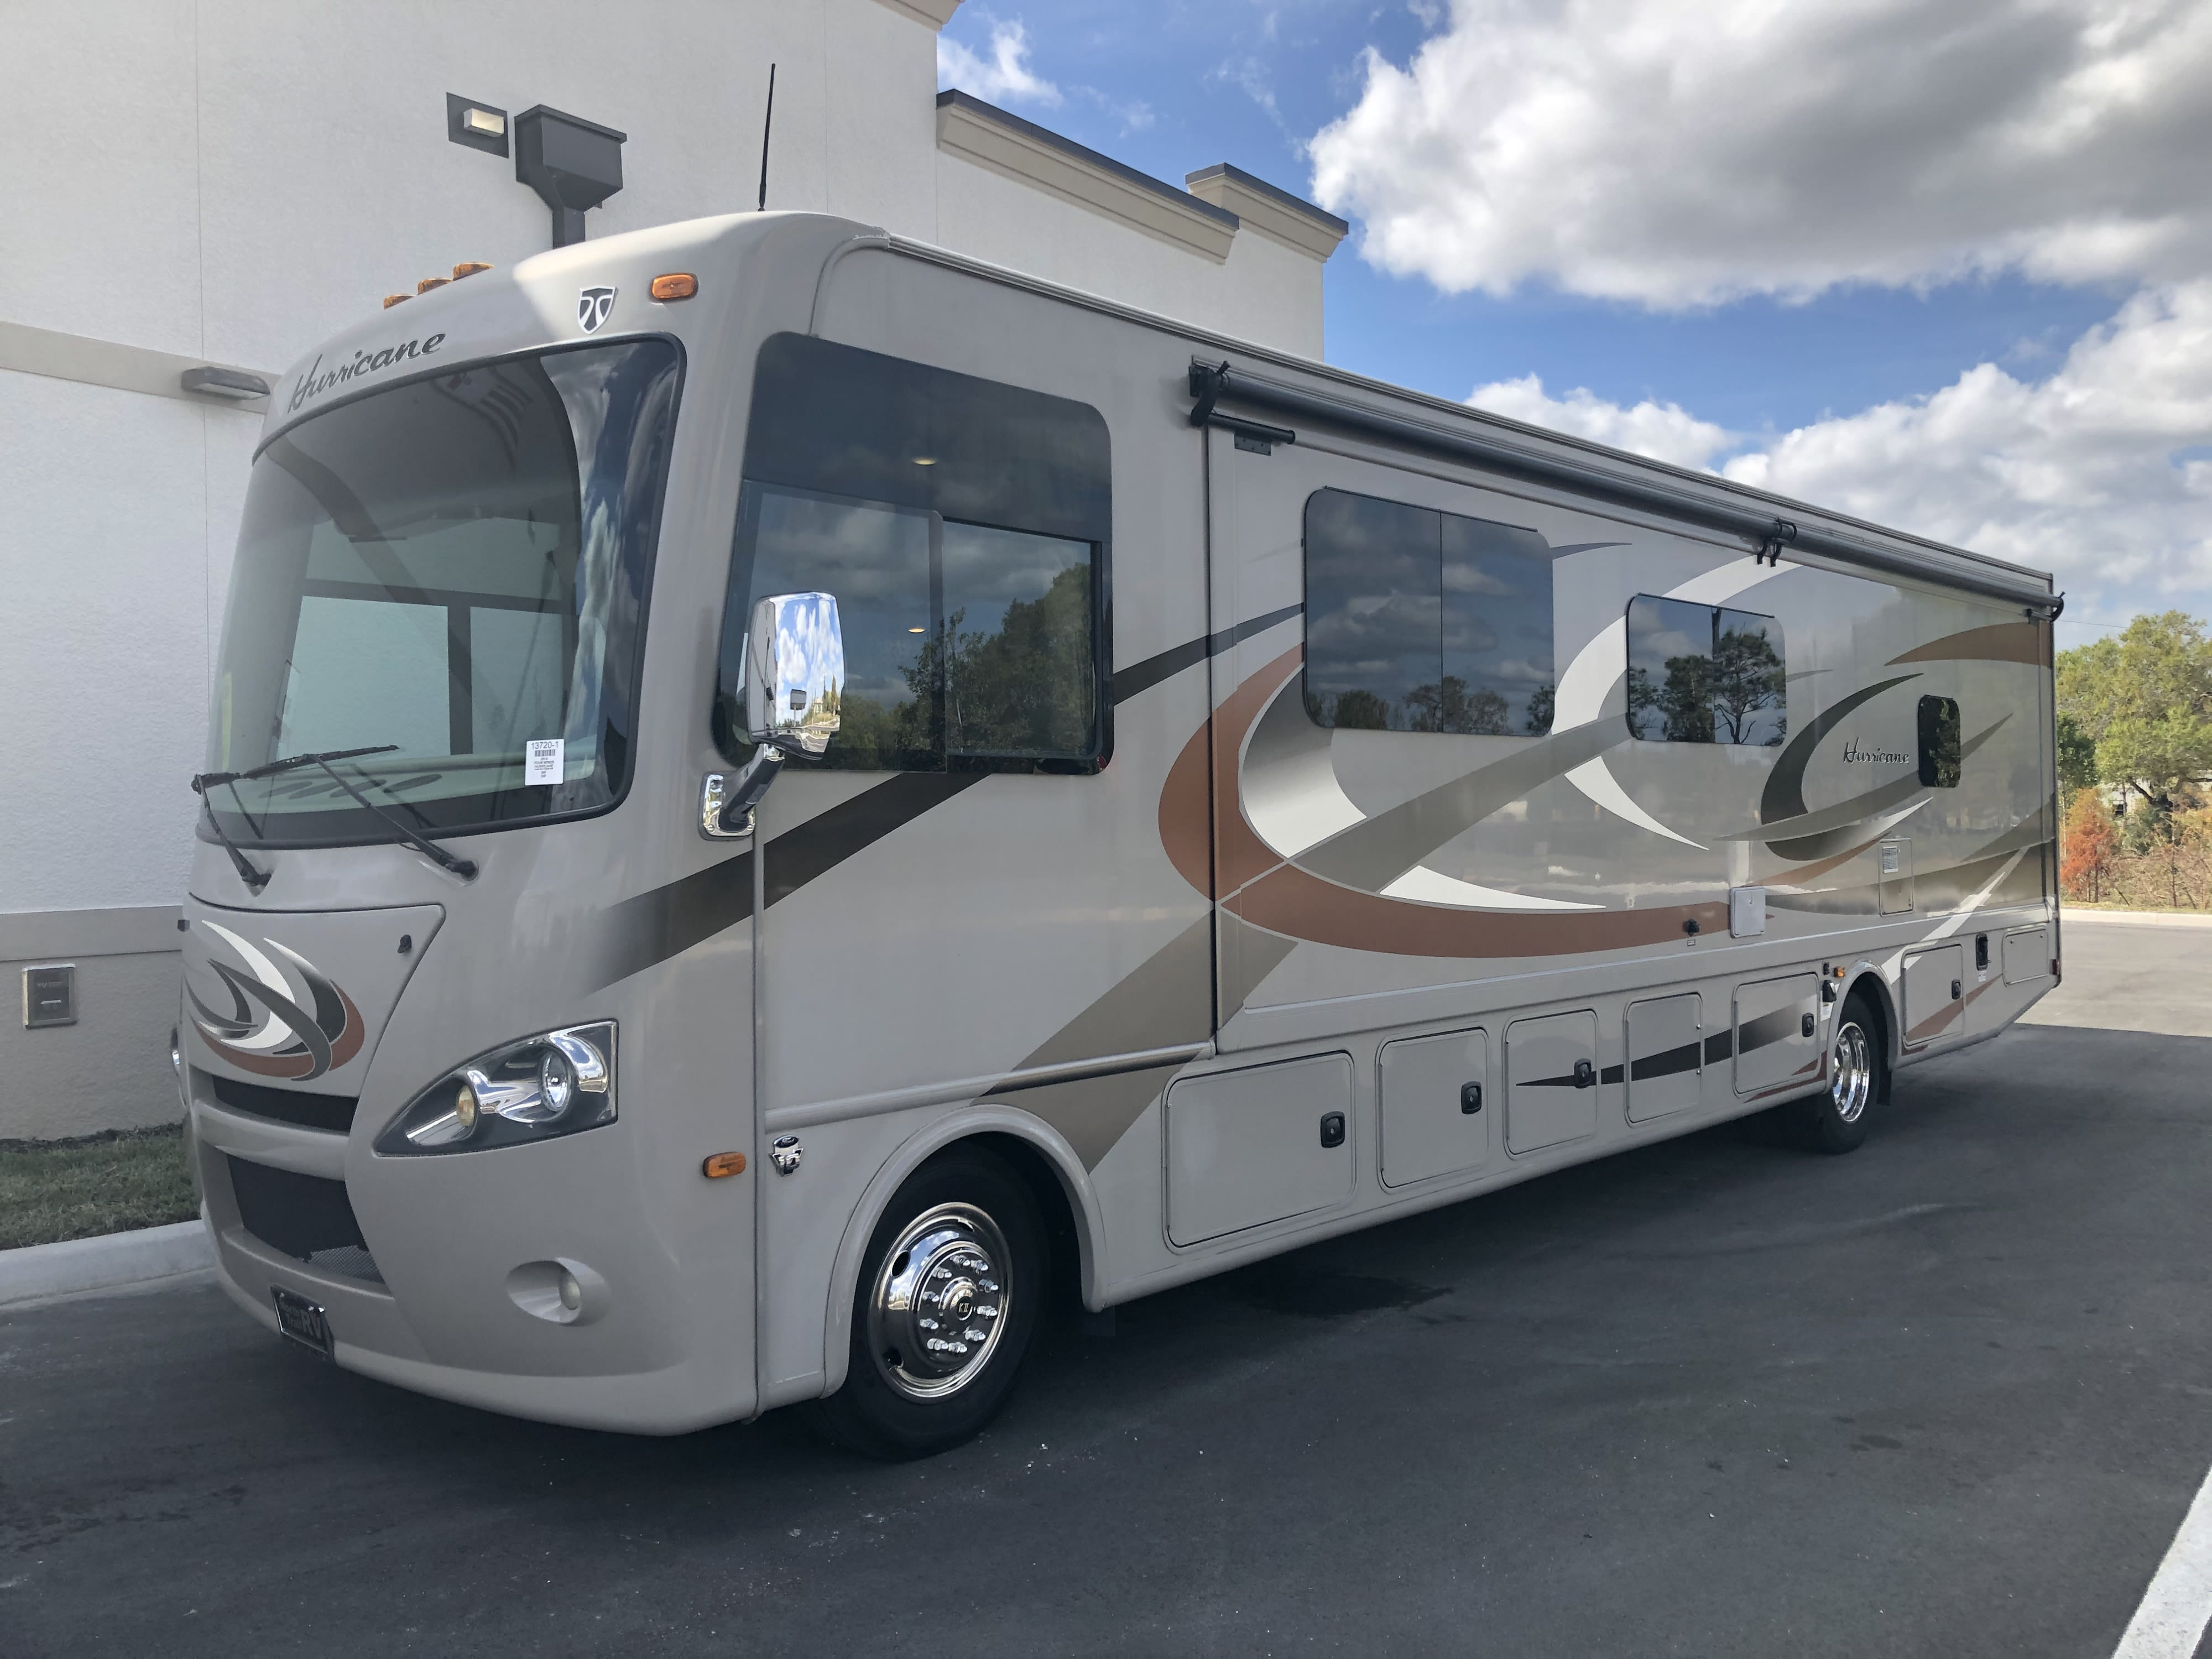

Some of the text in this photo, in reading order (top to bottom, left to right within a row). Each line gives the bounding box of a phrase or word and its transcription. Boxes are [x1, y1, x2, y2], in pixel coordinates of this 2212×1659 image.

[288, 332, 446, 414] Hurricane
[531, 741, 559, 749] 13720-1
[1843, 736, 1910, 764] Hurricane
